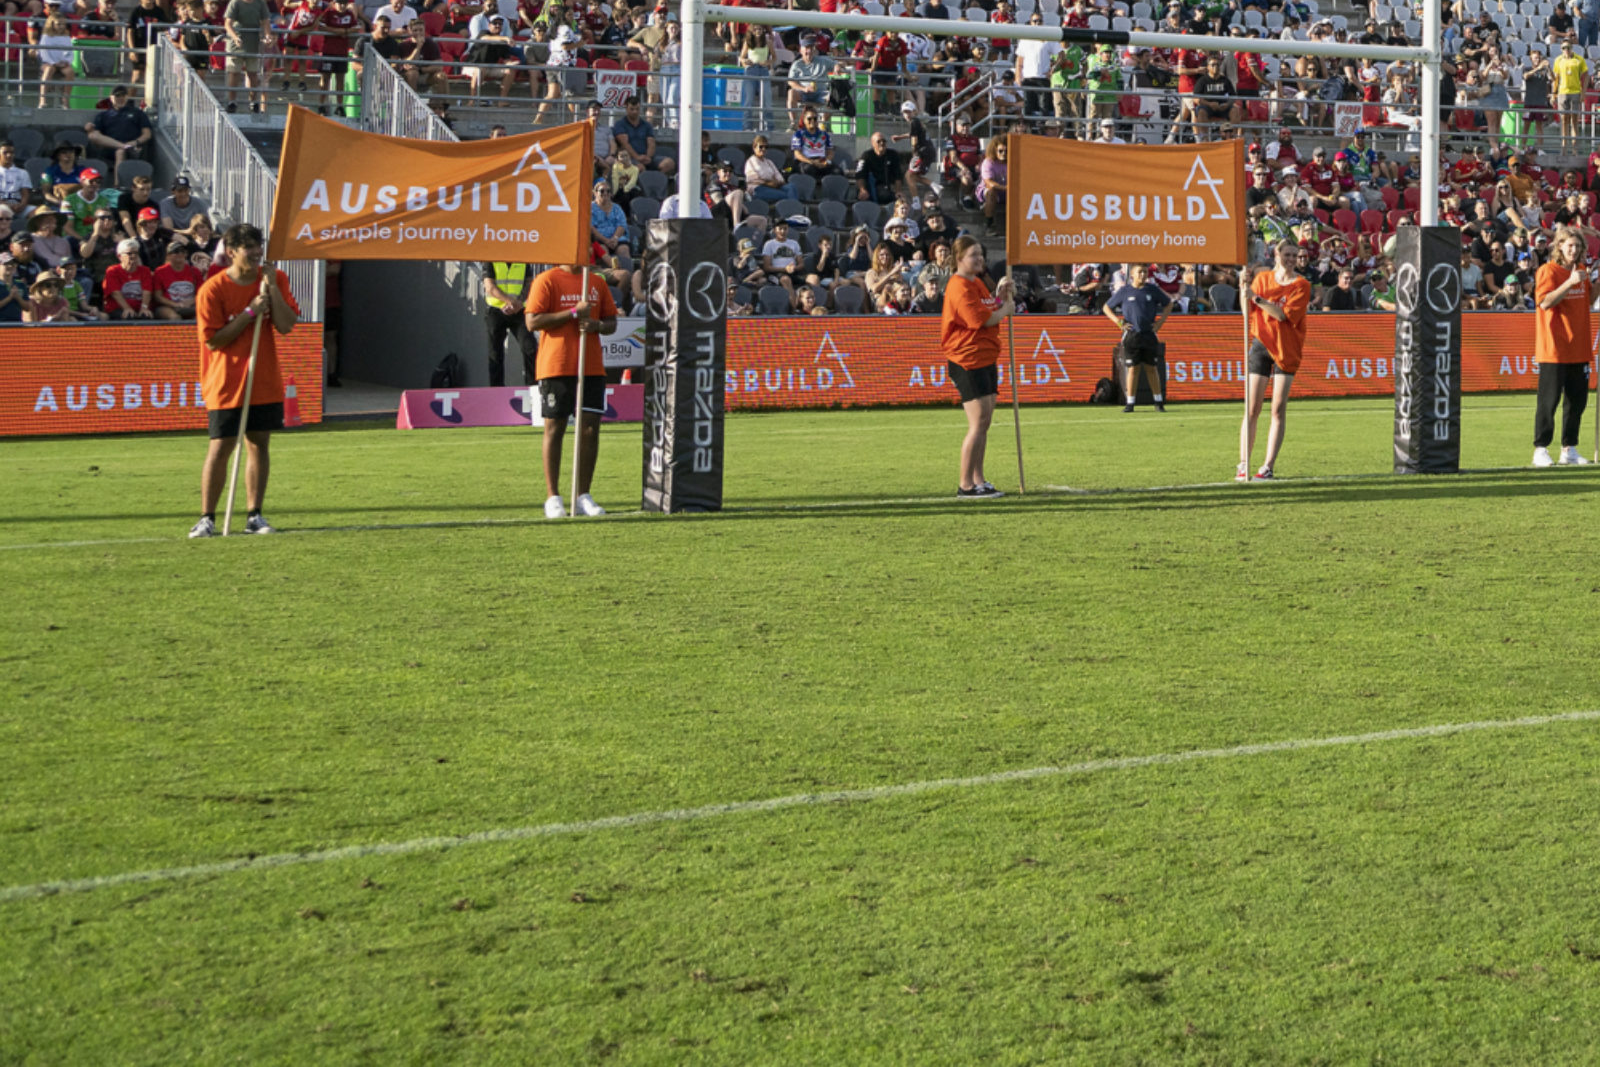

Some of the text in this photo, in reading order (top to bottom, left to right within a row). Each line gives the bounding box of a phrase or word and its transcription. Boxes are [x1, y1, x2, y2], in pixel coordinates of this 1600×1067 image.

[601, 74, 634, 85] POD
[602, 87, 633, 108] 20
[1337, 104, 1361, 115] POD
[301, 179, 541, 214] AUSBUILD
[1026, 193, 1206, 221] AUSBUILD
[296, 222, 540, 246] A simple journey home
[1027, 231, 1206, 249] A simple journey home
[610, 343, 632, 358] Bay
[725, 368, 834, 393] SBUILD
[1326, 358, 1396, 379] AUSB
[1400, 321, 1412, 439] mazda
[1434, 322, 1451, 440] mazda
[34, 382, 206, 412] AUSBUIL
[650, 331, 667, 472] mazda
[693, 330, 715, 472] mazda
